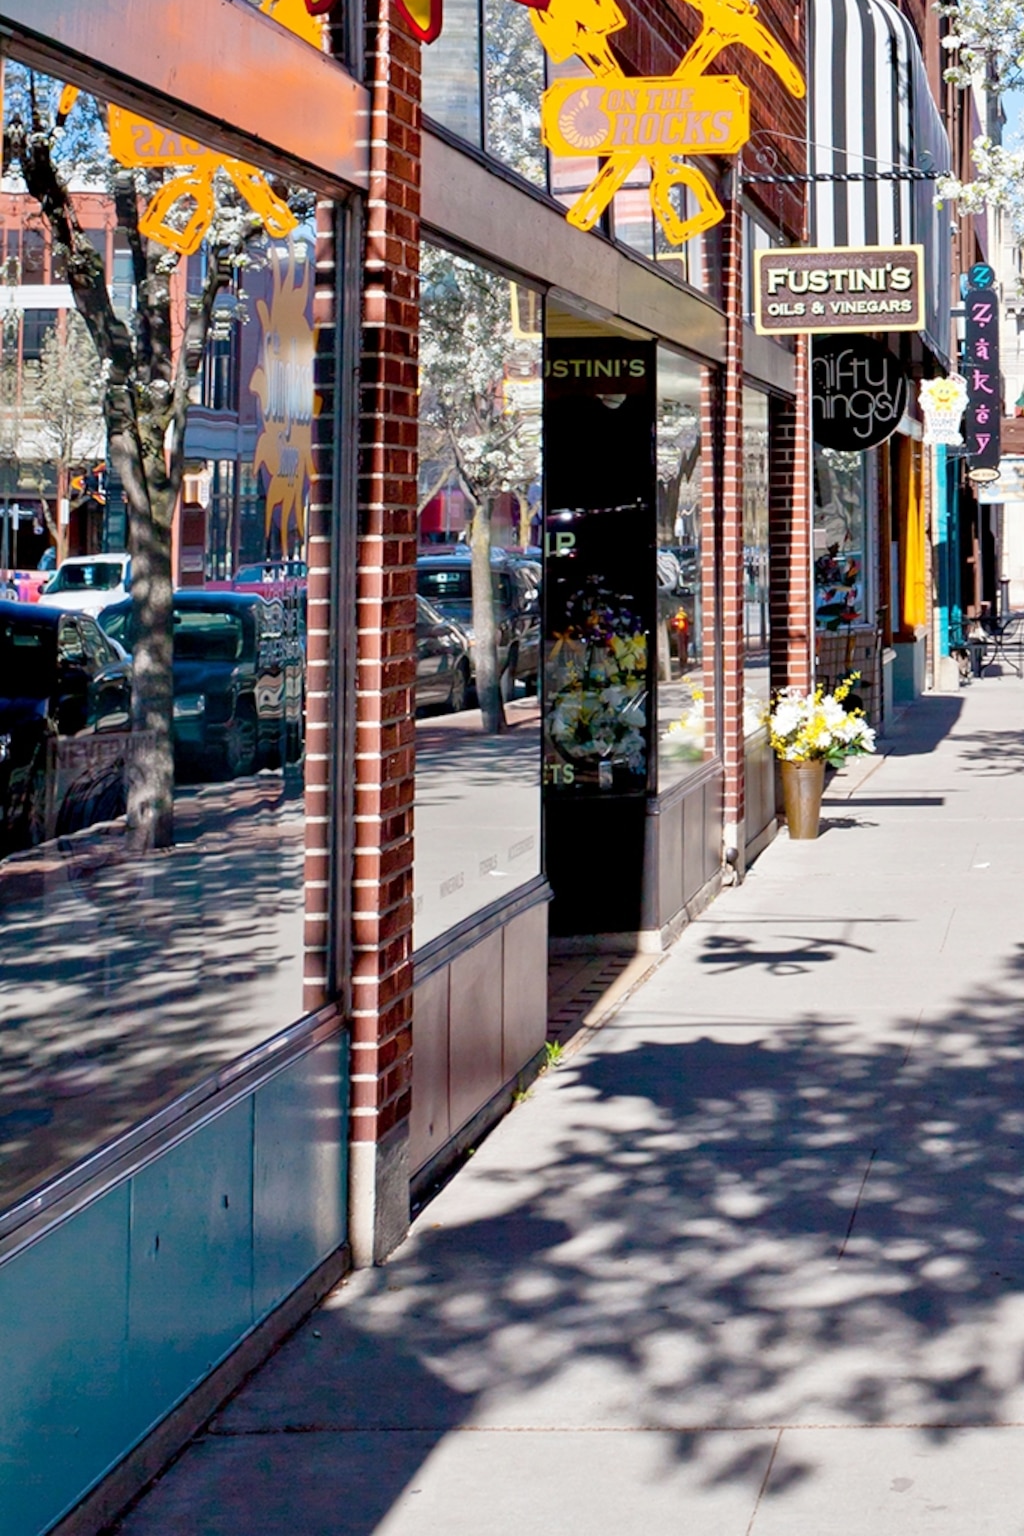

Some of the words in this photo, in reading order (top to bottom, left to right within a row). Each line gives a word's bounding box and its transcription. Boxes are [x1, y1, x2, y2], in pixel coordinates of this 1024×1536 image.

[606, 89, 639, 110] ON
[646, 88, 695, 110] THE
[611, 110, 733, 146] ROCKS
[767, 263, 912, 295] FUSTINI'S
[767, 302, 806, 317] OILS
[811, 301, 825, 315] &
[830, 299, 912, 314] VINEGARS
